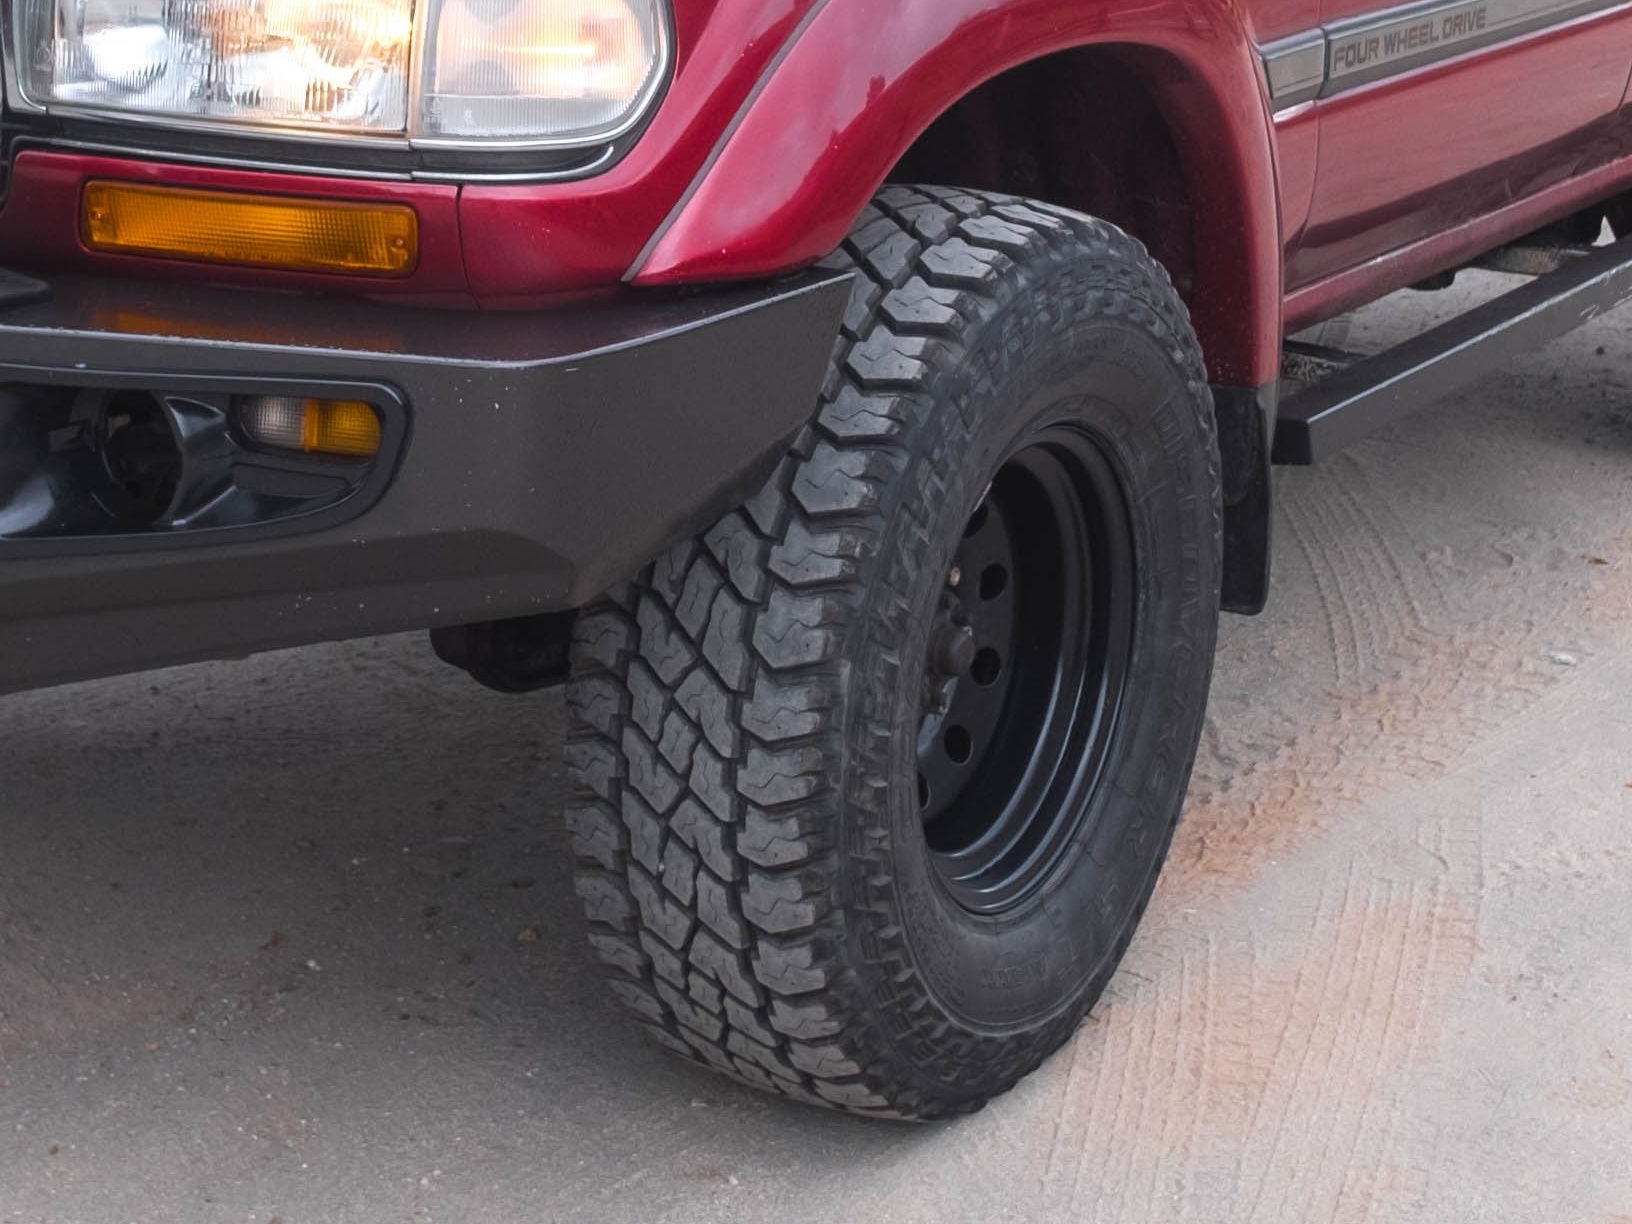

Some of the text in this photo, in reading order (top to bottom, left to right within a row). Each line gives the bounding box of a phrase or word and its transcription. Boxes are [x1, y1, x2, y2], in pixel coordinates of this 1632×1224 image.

[1334, 8, 1487, 71] FOUR WHEEL DRIVE
